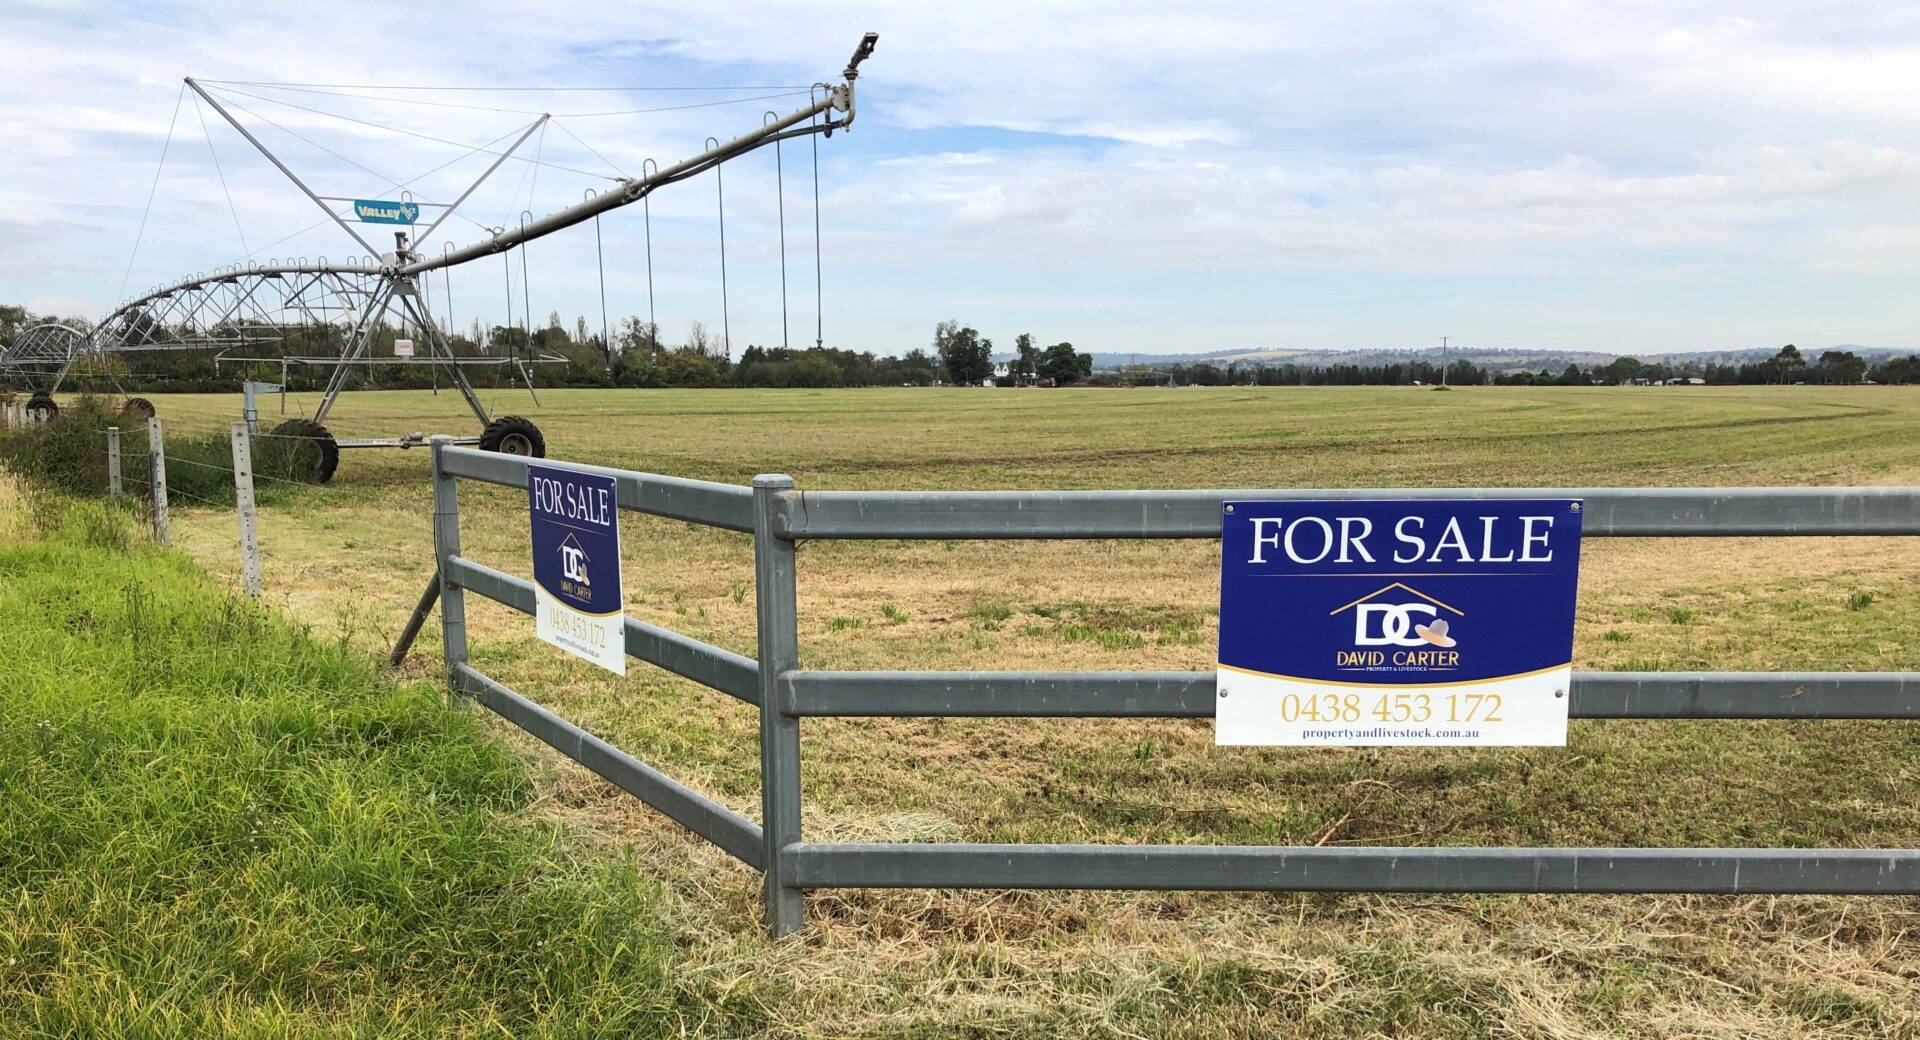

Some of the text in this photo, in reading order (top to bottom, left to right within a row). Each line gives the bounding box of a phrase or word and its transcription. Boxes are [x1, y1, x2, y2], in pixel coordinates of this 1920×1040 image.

[534, 477, 610, 526] FOR SALE
[1247, 515, 1554, 564] FOR SALE
[549, 607, 569, 633] 0438
[572, 616, 587, 641] 453
[590, 622, 606, 649] 172
[1337, 651, 1460, 666] DAVID CARTER
[1281, 693, 1503, 723] 0438 453 172
[1302, 727, 1479, 740] propertyandlivestock.com.au
